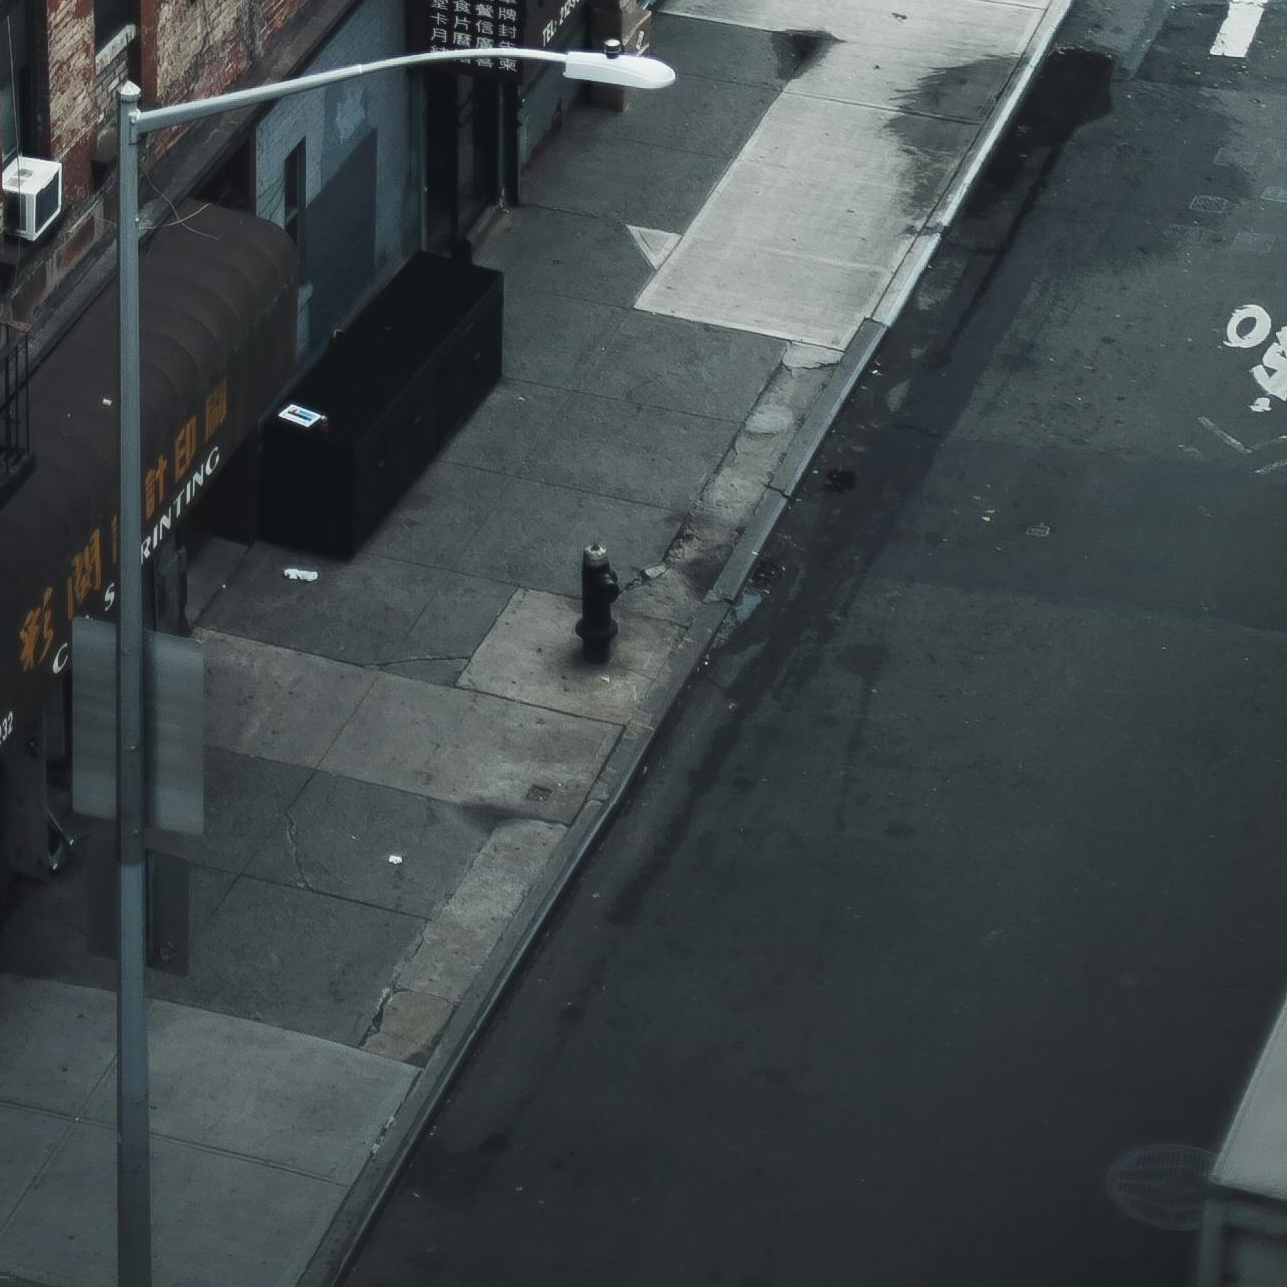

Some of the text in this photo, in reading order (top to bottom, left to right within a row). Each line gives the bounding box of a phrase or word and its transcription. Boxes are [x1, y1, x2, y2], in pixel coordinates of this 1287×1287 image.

[52, 445, 221, 674] C S RINTING
